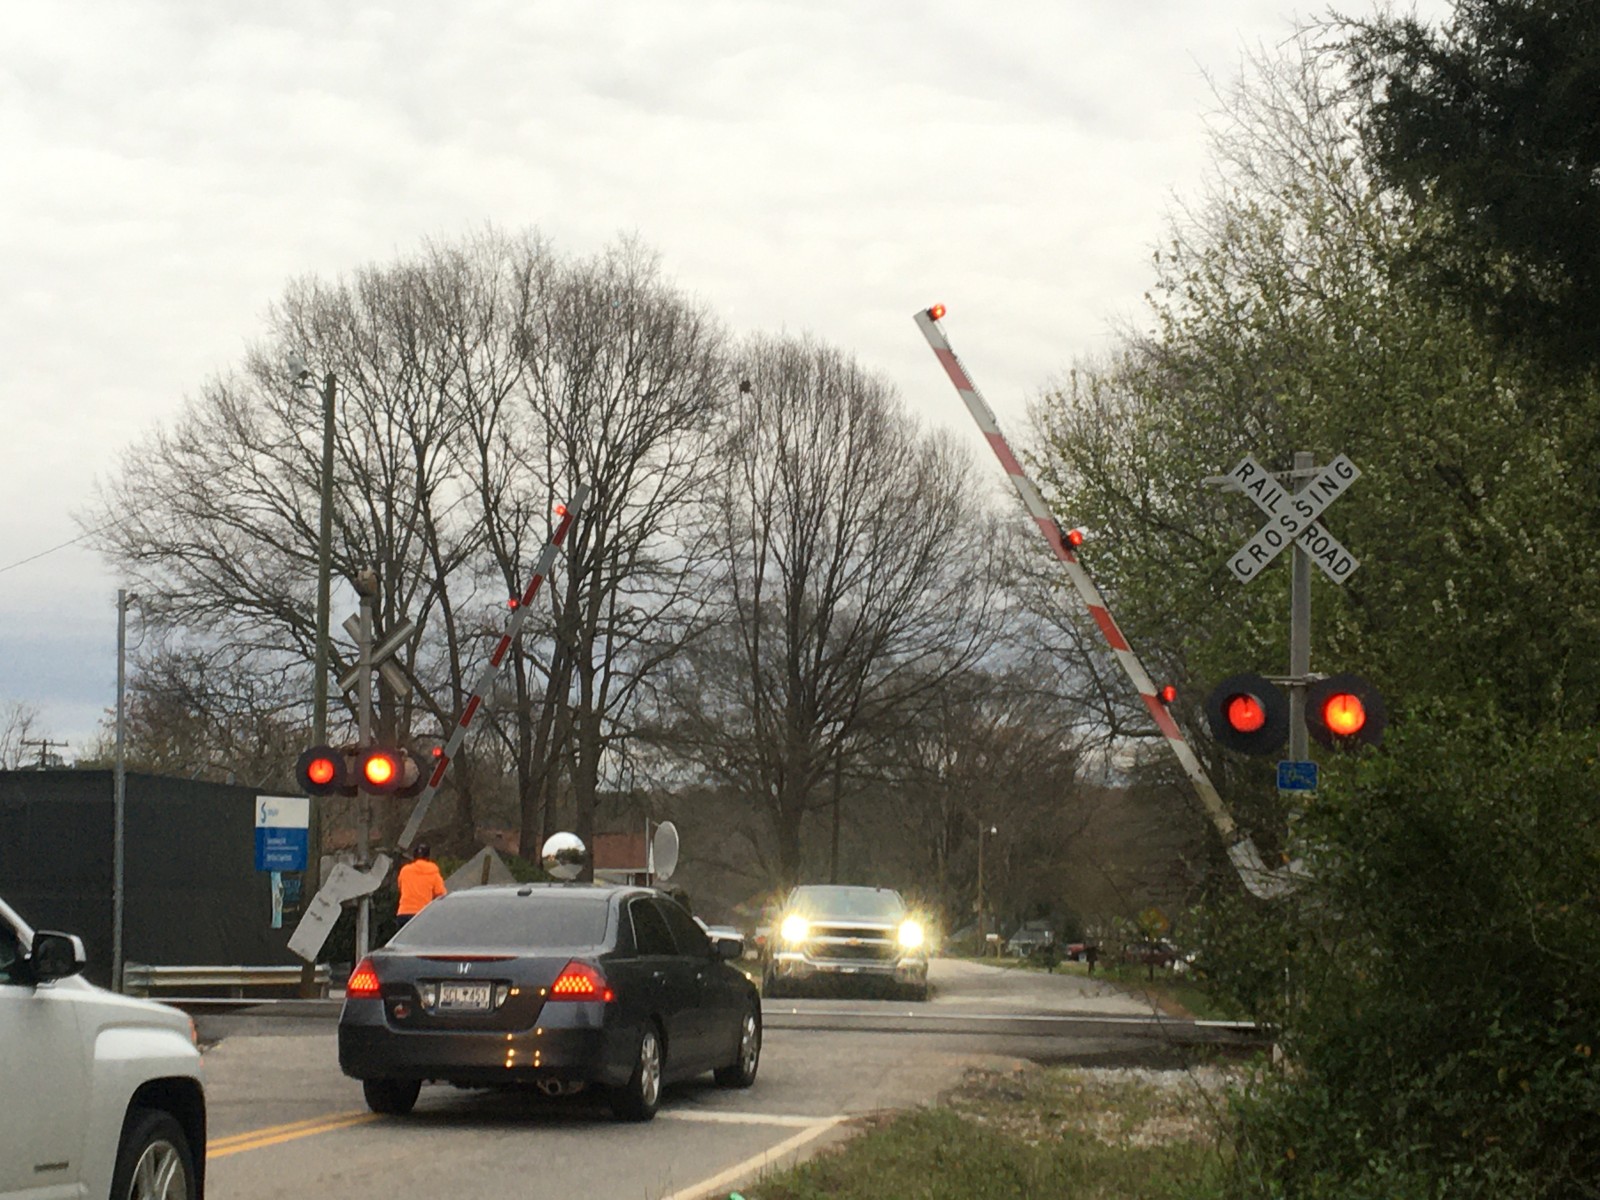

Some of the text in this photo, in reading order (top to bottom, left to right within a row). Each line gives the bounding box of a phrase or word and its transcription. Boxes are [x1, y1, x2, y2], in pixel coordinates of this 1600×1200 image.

[1234, 461, 1354, 576] CROSSING
[1235, 462, 1352, 576] RAIL ROAD
